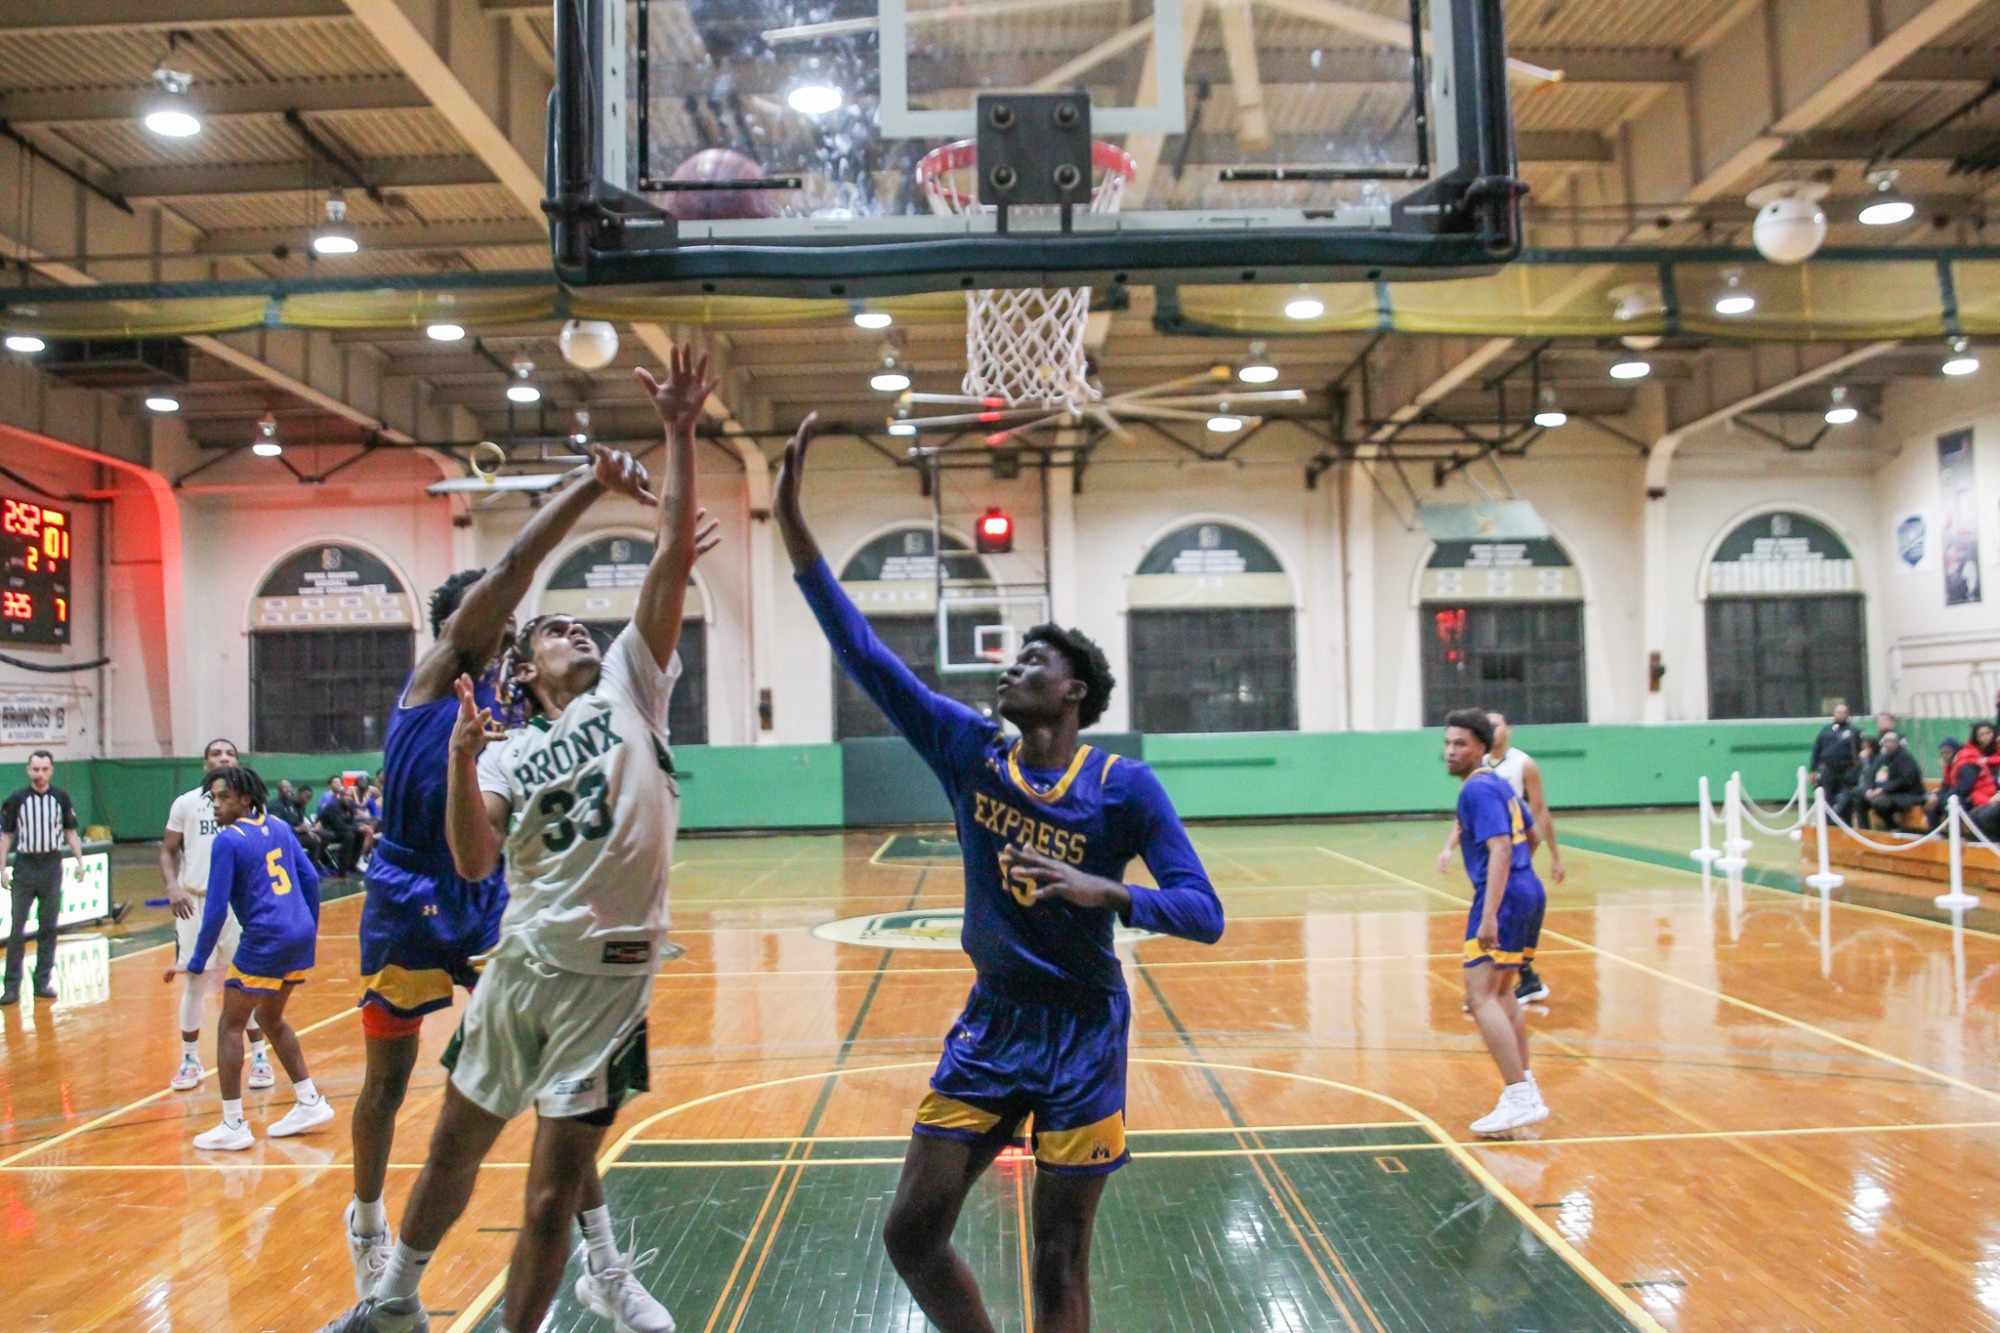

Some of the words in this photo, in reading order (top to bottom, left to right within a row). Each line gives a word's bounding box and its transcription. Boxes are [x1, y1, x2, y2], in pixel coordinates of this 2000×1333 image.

[26, 546, 39, 572] 2
[54, 598, 66, 622] 7
[514, 710, 623, 800] BRONX
[539, 772, 614, 853] 33
[974, 792, 1087, 864] EXPRESS
[265, 847, 293, 896] 5
